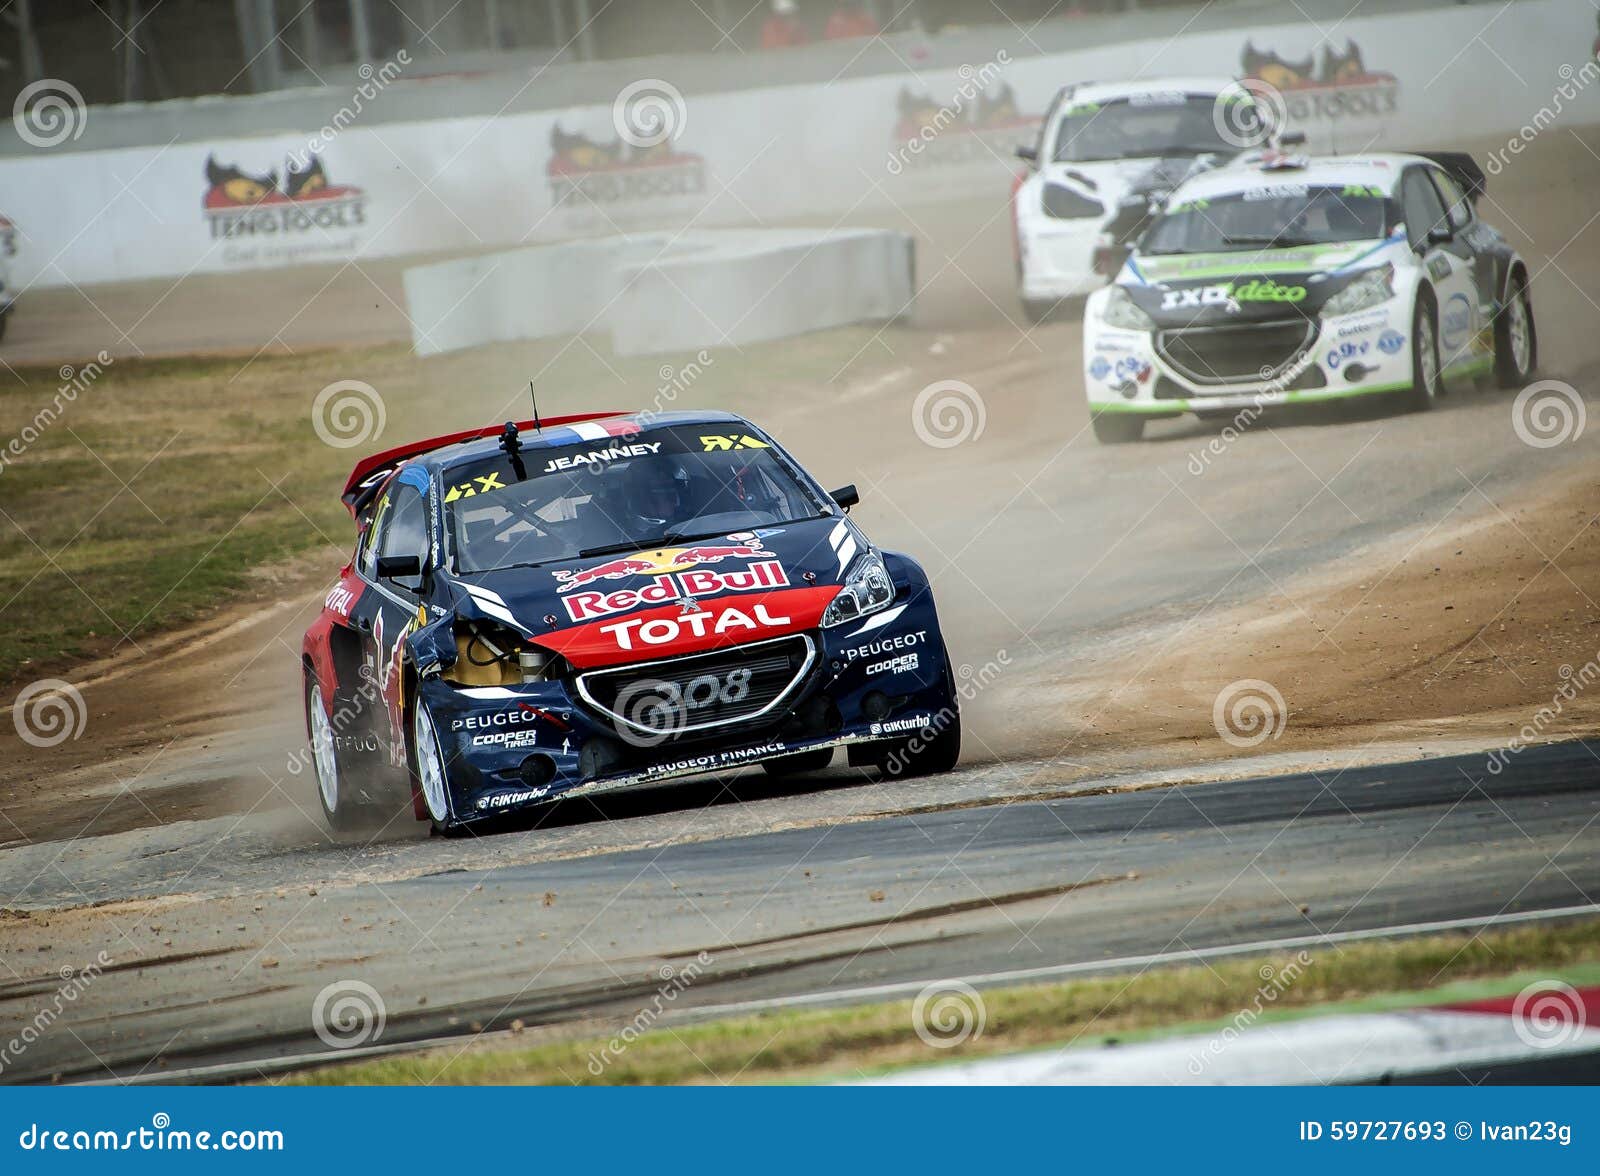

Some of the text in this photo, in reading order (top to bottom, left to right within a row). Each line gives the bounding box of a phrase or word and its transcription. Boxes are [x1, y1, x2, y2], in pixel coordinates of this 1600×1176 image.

[544, 442, 661, 473] JEANNEY
[561, 560, 790, 622] Red Bull
[600, 605, 790, 650] TOTAL
[846, 630, 927, 661] PEUGEOT
[866, 652, 918, 676] COOPER
[892, 661, 919, 675] TIRES
[648, 668, 752, 716] 208
[472, 729, 537, 747] COOPER
[503, 738, 536, 749] TIRES
[647, 742, 786, 776] PEUGEOT FINANCE
